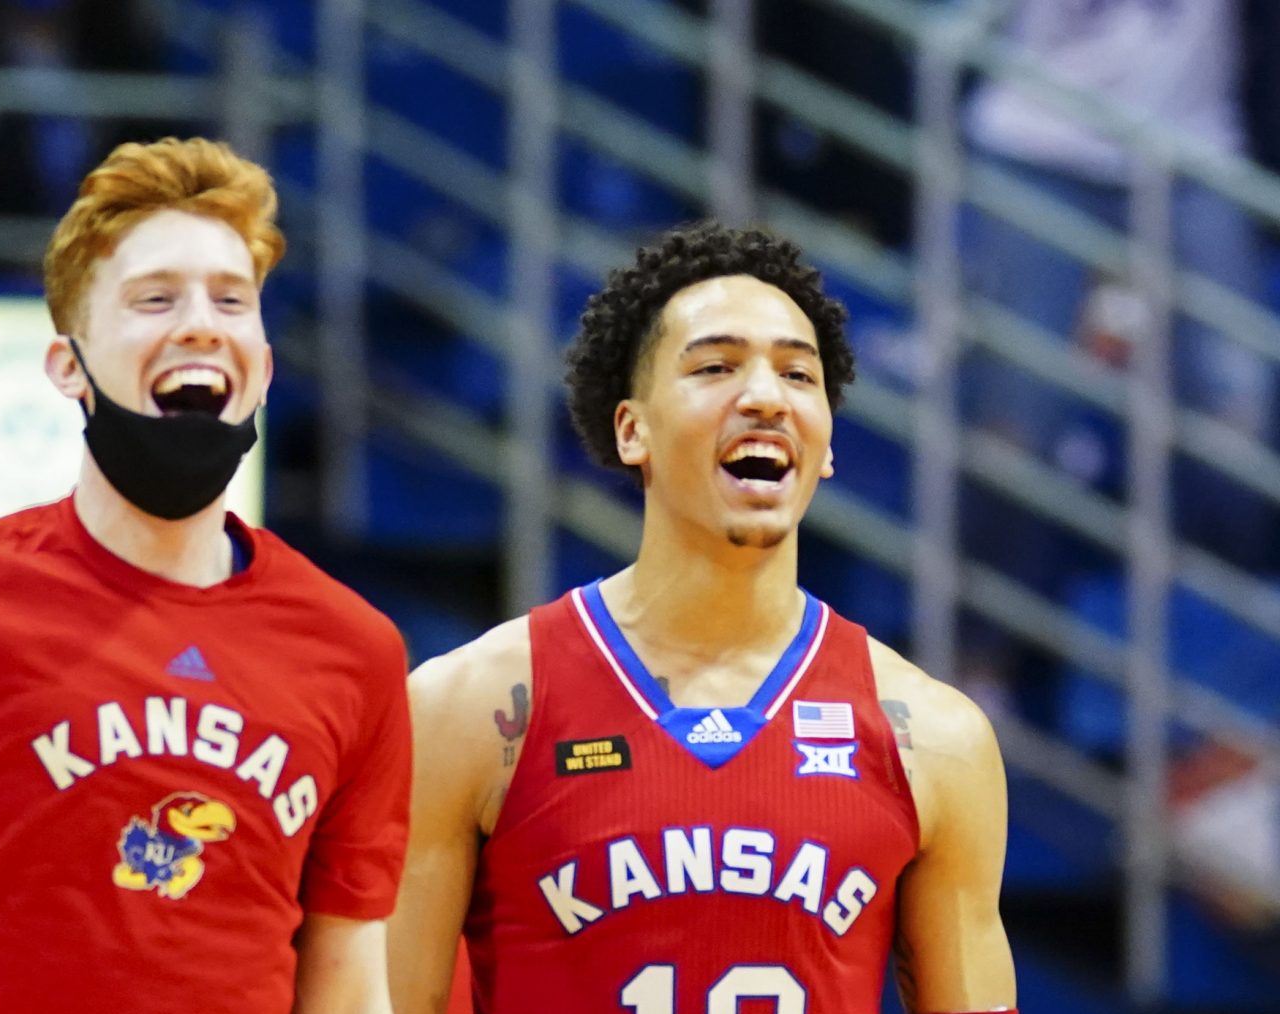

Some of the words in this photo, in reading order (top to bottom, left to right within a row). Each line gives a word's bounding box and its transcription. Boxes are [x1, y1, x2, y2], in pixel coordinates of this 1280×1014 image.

[687, 731, 742, 744] adidas
[573, 740, 613, 757] UNITED
[31, 697, 318, 837] KANSAS
[565, 757, 584, 771] WE
[585, 752, 622, 769] STAND
[538, 826, 878, 937] KANSAS
